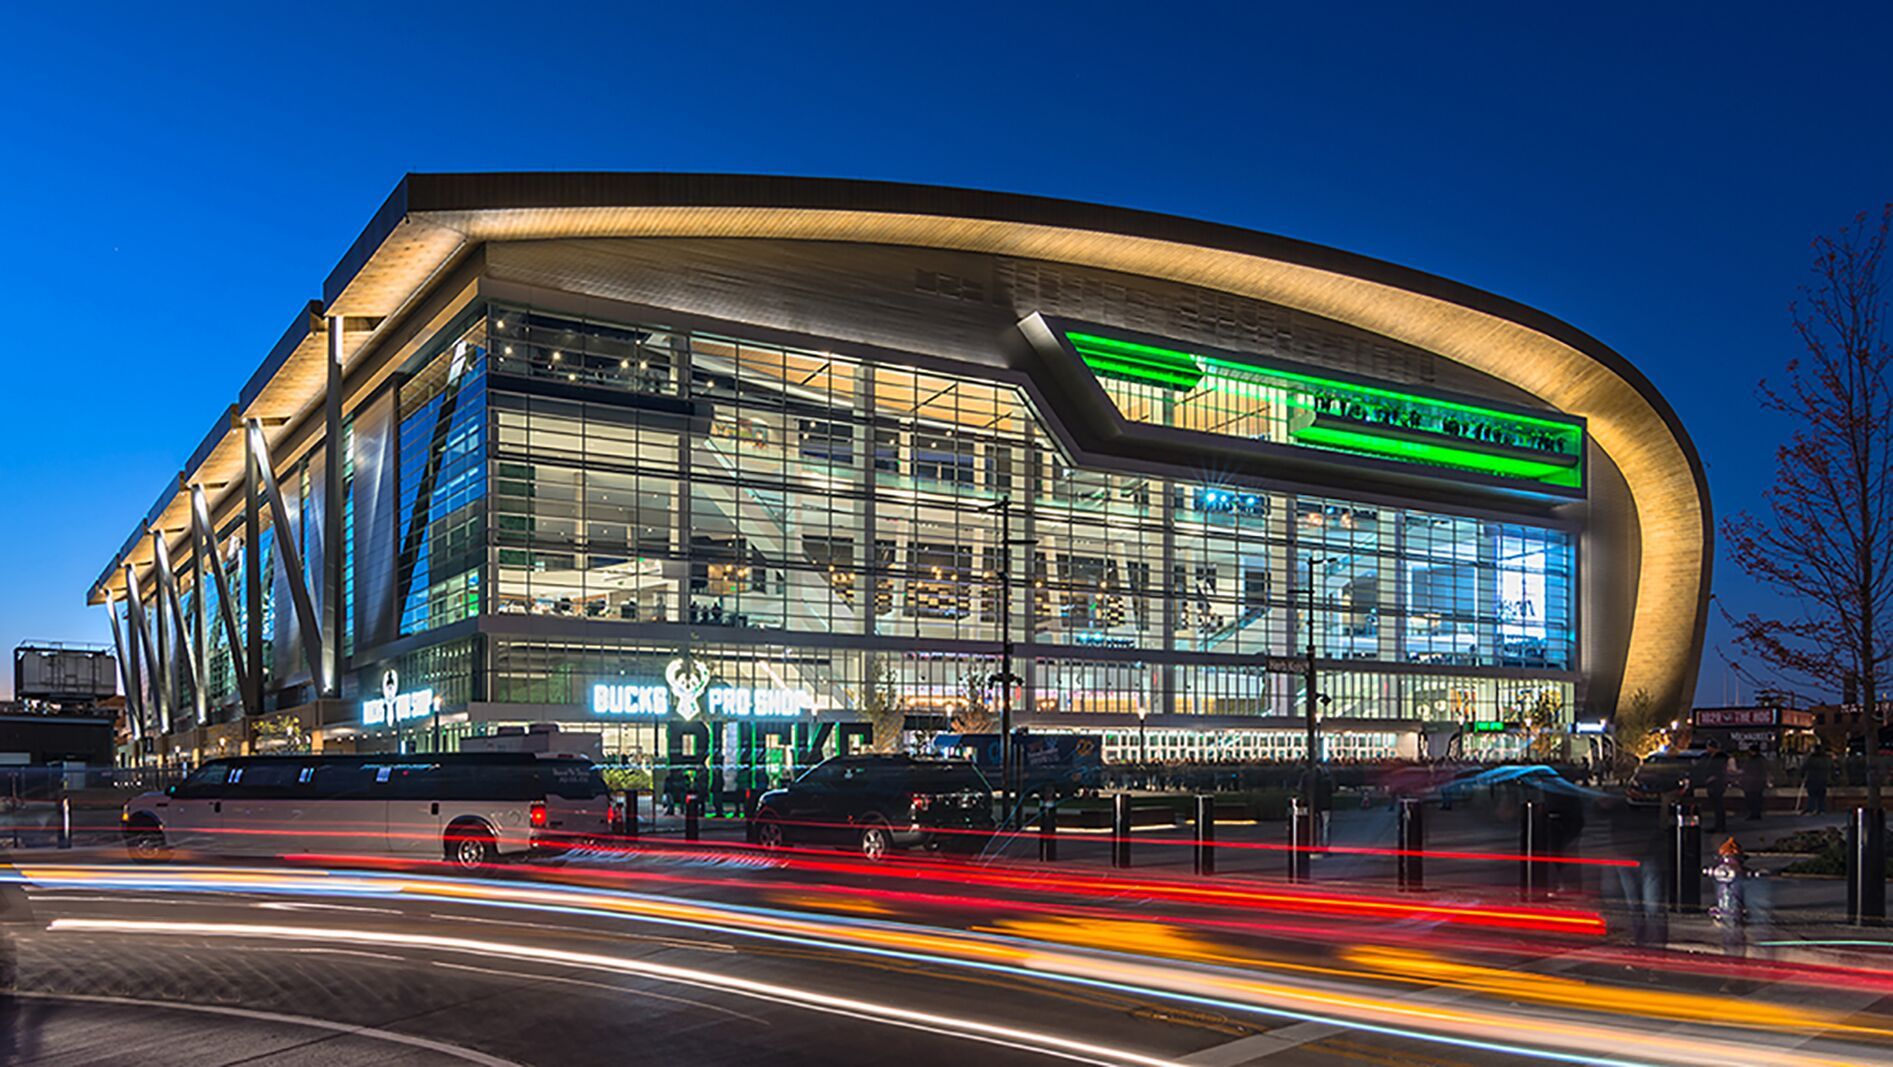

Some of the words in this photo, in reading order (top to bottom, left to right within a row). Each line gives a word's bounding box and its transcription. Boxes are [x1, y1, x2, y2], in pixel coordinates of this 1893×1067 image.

[593, 685, 669, 714] BUCKS
[708, 688, 750, 715] PRO
[754, 689, 807, 716] SHOP
